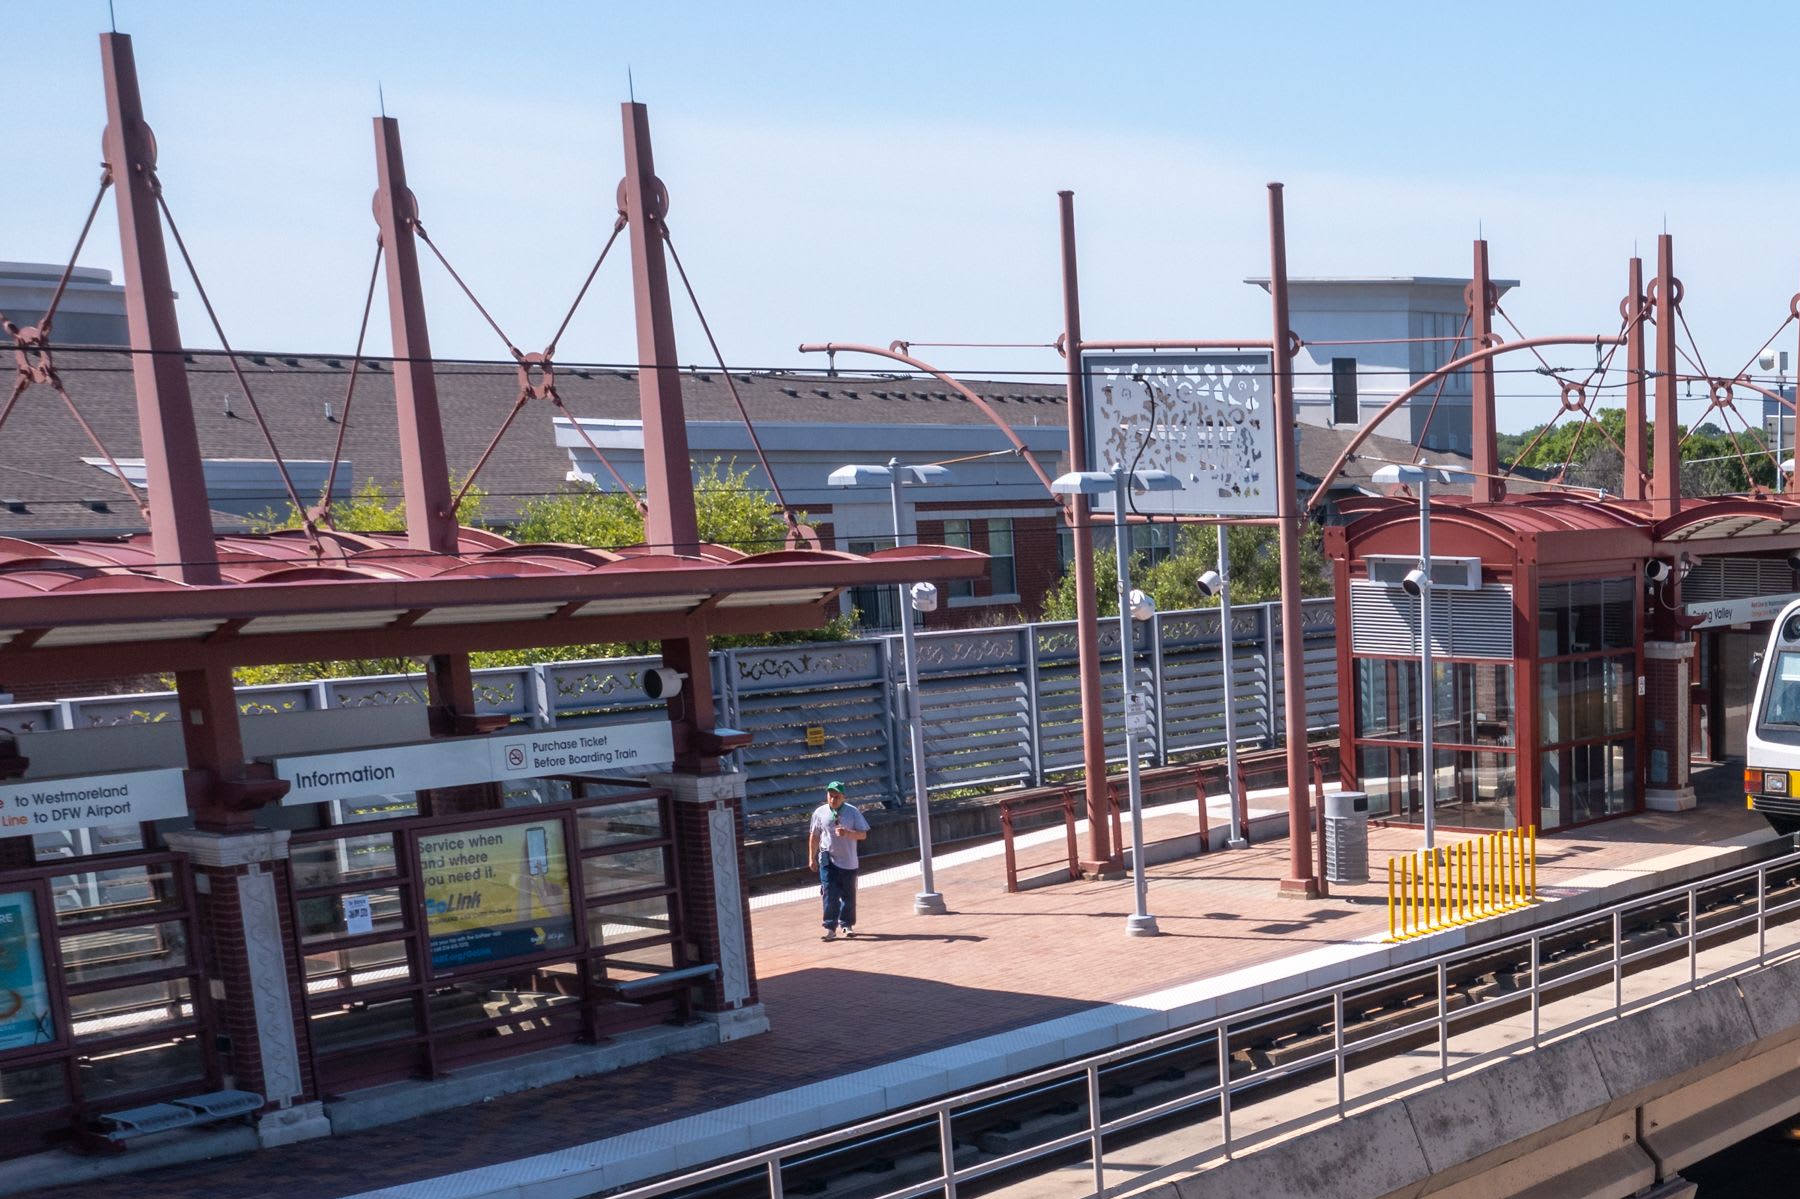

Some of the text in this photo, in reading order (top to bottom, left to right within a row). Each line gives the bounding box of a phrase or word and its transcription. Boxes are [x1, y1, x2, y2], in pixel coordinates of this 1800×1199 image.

[1713, 607, 1733, 620] Valley
[532, 735, 608, 752] Purchase Ticket
[534, 748, 638, 768] Before Boarding Train
[296, 765, 395, 788] Information
[15, 795, 29, 808] to
[32, 784, 128, 806] Westmoreland
[2, 801, 131, 827] Line to DFW Airport
[418, 834, 503, 854] Service when
[449, 852, 488, 866] where
[448, 868, 481, 883] need
[484, 866, 496, 879] it.
